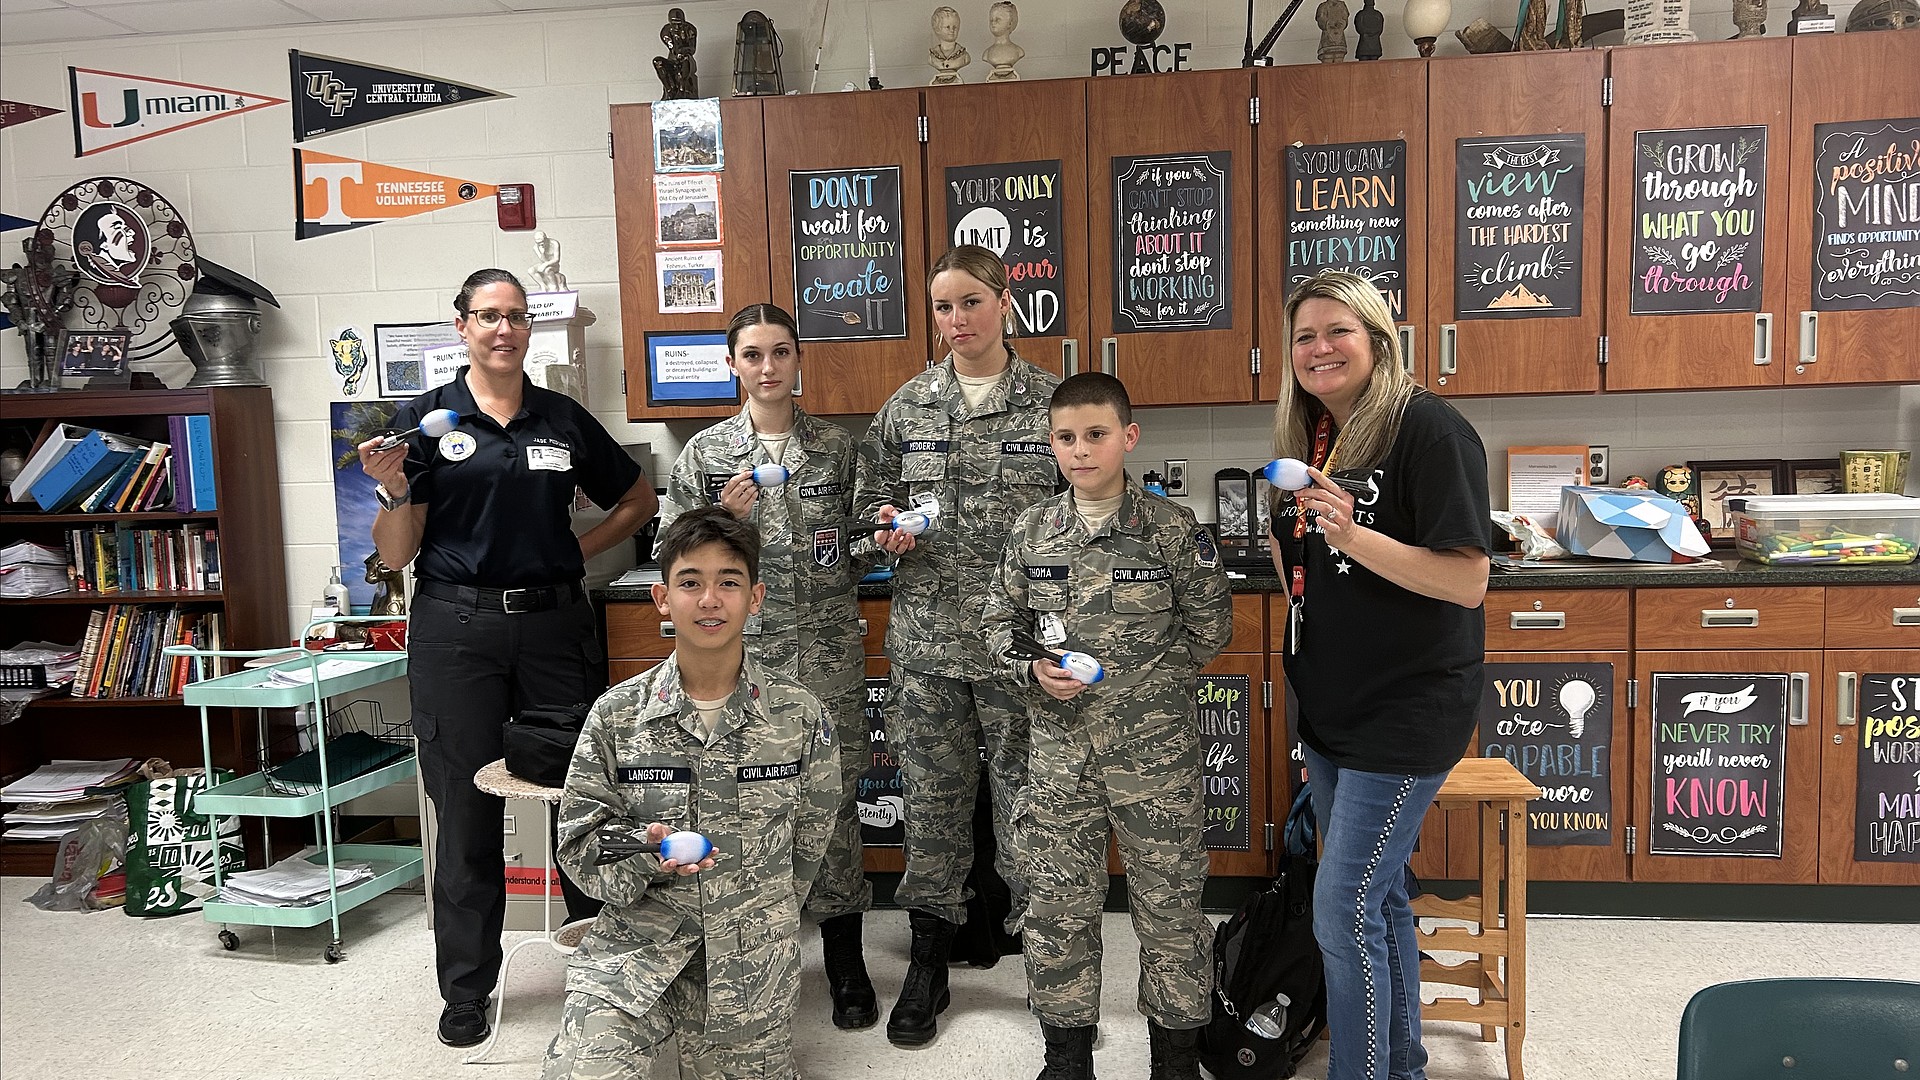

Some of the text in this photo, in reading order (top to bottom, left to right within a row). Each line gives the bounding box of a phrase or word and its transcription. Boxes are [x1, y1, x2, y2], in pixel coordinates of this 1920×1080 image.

[1091, 43, 1192, 76] PEACE
[302, 71, 358, 116] UCF
[366, 93, 442, 103] CENTRAL FLORIDA
[372, 84, 435, 93] UNIVERSITY OF
[1302, 147, 1384, 174] YOU CAN
[1667, 143, 1735, 175] GROW
[1839, 137, 1868, 161] A
[1151, 168, 1192, 187] if you
[1831, 140, 1920, 196] positiv
[305, 162, 363, 225] T
[376, 181, 444, 193] TENNESSEE
[809, 173, 878, 209] DON'T
[951, 173, 1056, 205] YOUR ONLY
[1295, 175, 1396, 212] LEARN
[1467, 164, 1574, 203] view
[1642, 167, 1758, 208] through
[376, 194, 446, 206] VOLUNTEERS
[1176, 187, 1214, 208] STOP
[1466, 197, 1572, 222] comes after
[801, 209, 890, 242] wait for
[1127, 206, 1217, 235] thinking
[1290, 214, 1402, 234] something new
[1643, 209, 1755, 240] WHAT YOU
[960, 219, 1049, 249] LIMIT is
[1135, 231, 1206, 256] ABOUT IT
[1468, 222, 1572, 247] THE HARDEST
[1827, 231, 1855, 246] FINDS
[801, 241, 896, 260] OPPORTUNITY
[1175, 250, 1213, 276] stop
[1289, 234, 1401, 267] EVERYDAY
[1681, 240, 1720, 273] go
[1481, 244, 1558, 285] climb
[1827, 249, 1920, 285] everythin
[803, 259, 894, 305] create
[1129, 275, 1215, 301] WORKING
[1640, 262, 1753, 303] through
[865, 298, 889, 330] IT
[1007, 289, 1059, 334] ND
[1156, 301, 1189, 320] for it
[434, 367, 448, 375] BAD
[1006, 443, 1023, 452] CIVIL
[1023, 444, 1036, 454] AIR
[801, 487, 817, 497] CIVIL
[818, 486, 828, 495] AIR
[1114, 569, 1134, 580] CIVIL
[1135, 569, 1150, 581] AIR
[1197, 681, 1241, 709] stop
[1493, 679, 1541, 708] YOU
[1699, 695, 1740, 711] if you
[1496, 712, 1555, 737] are
[1661, 723, 1775, 744] NEVER TRY
[1206, 742, 1239, 772] life
[1718, 754, 1771, 769] never
[628, 769, 674, 781] LANGSTON
[743, 763, 798, 779] CIVIL AIR PATROL
[858, 777, 887, 797] you
[1203, 776, 1240, 796] TOPS
[1666, 777, 1768, 819] KNOW
[859, 807, 893, 824] stently
[1530, 812, 1608, 831] YOU KNOW
[164, 849, 178, 865] TO
[505, 876, 540, 886] nderstand
